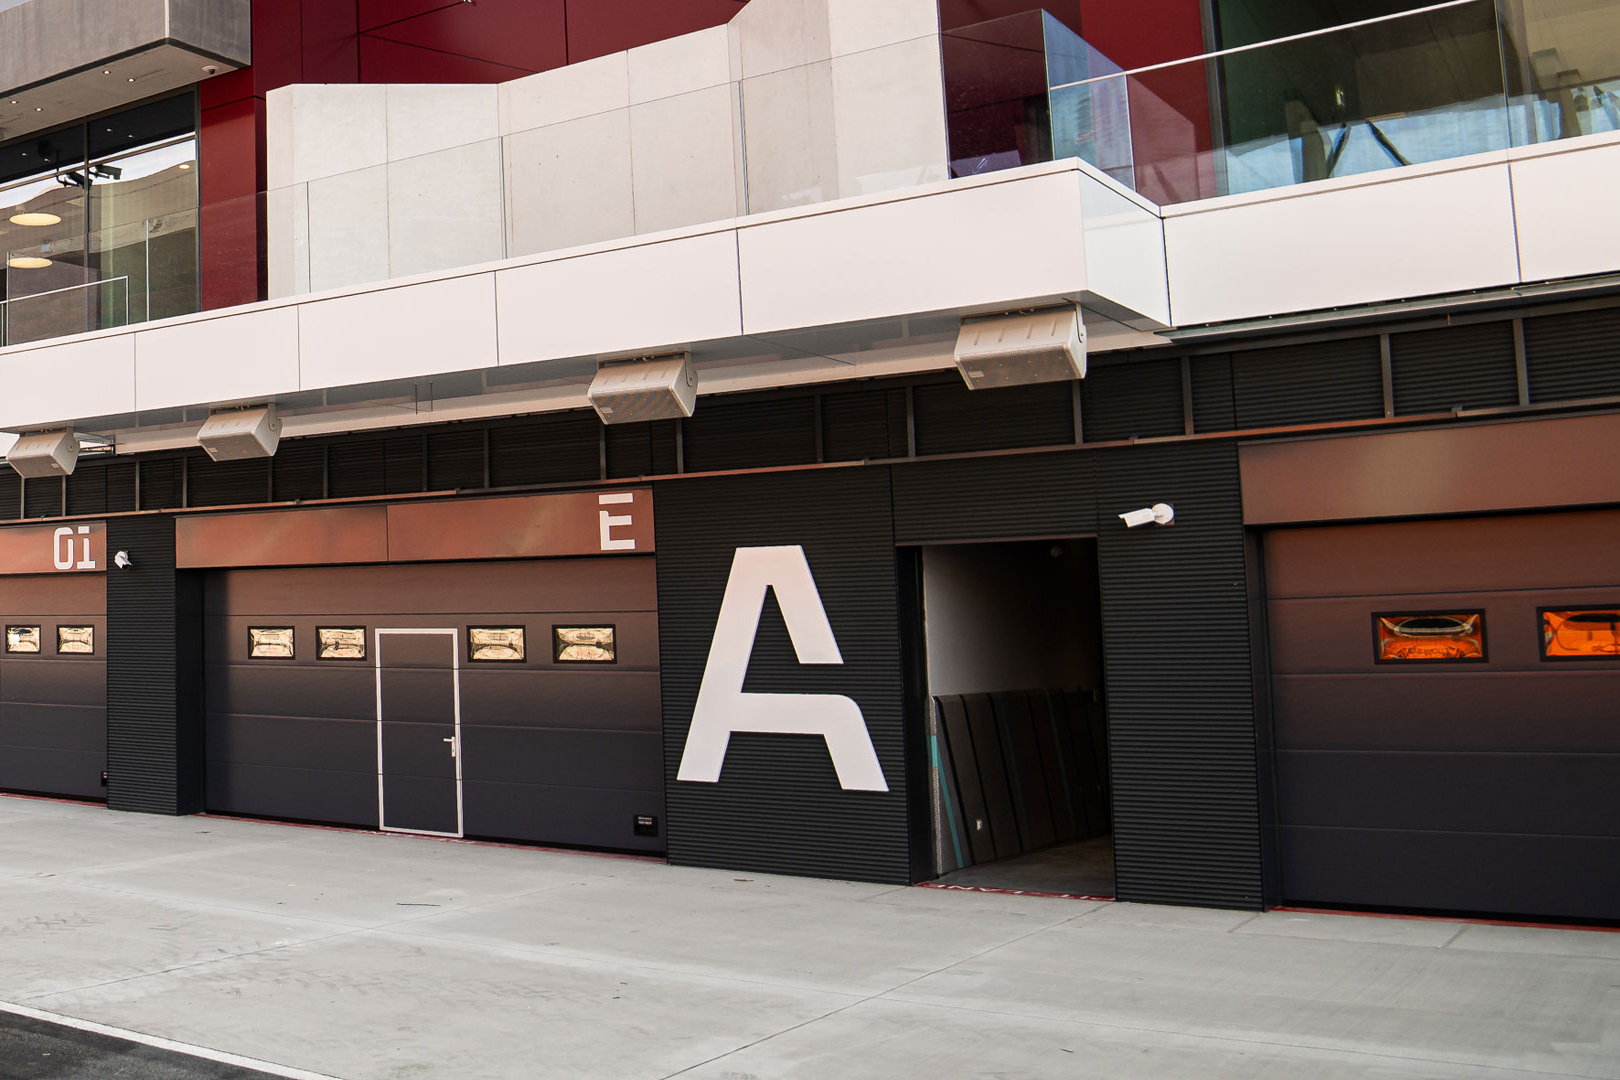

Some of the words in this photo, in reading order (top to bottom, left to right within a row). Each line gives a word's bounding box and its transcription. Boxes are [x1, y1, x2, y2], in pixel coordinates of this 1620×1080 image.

[53, 525, 96, 570] 01
[598, 492, 636, 551] E
[676, 544, 890, 793] A
